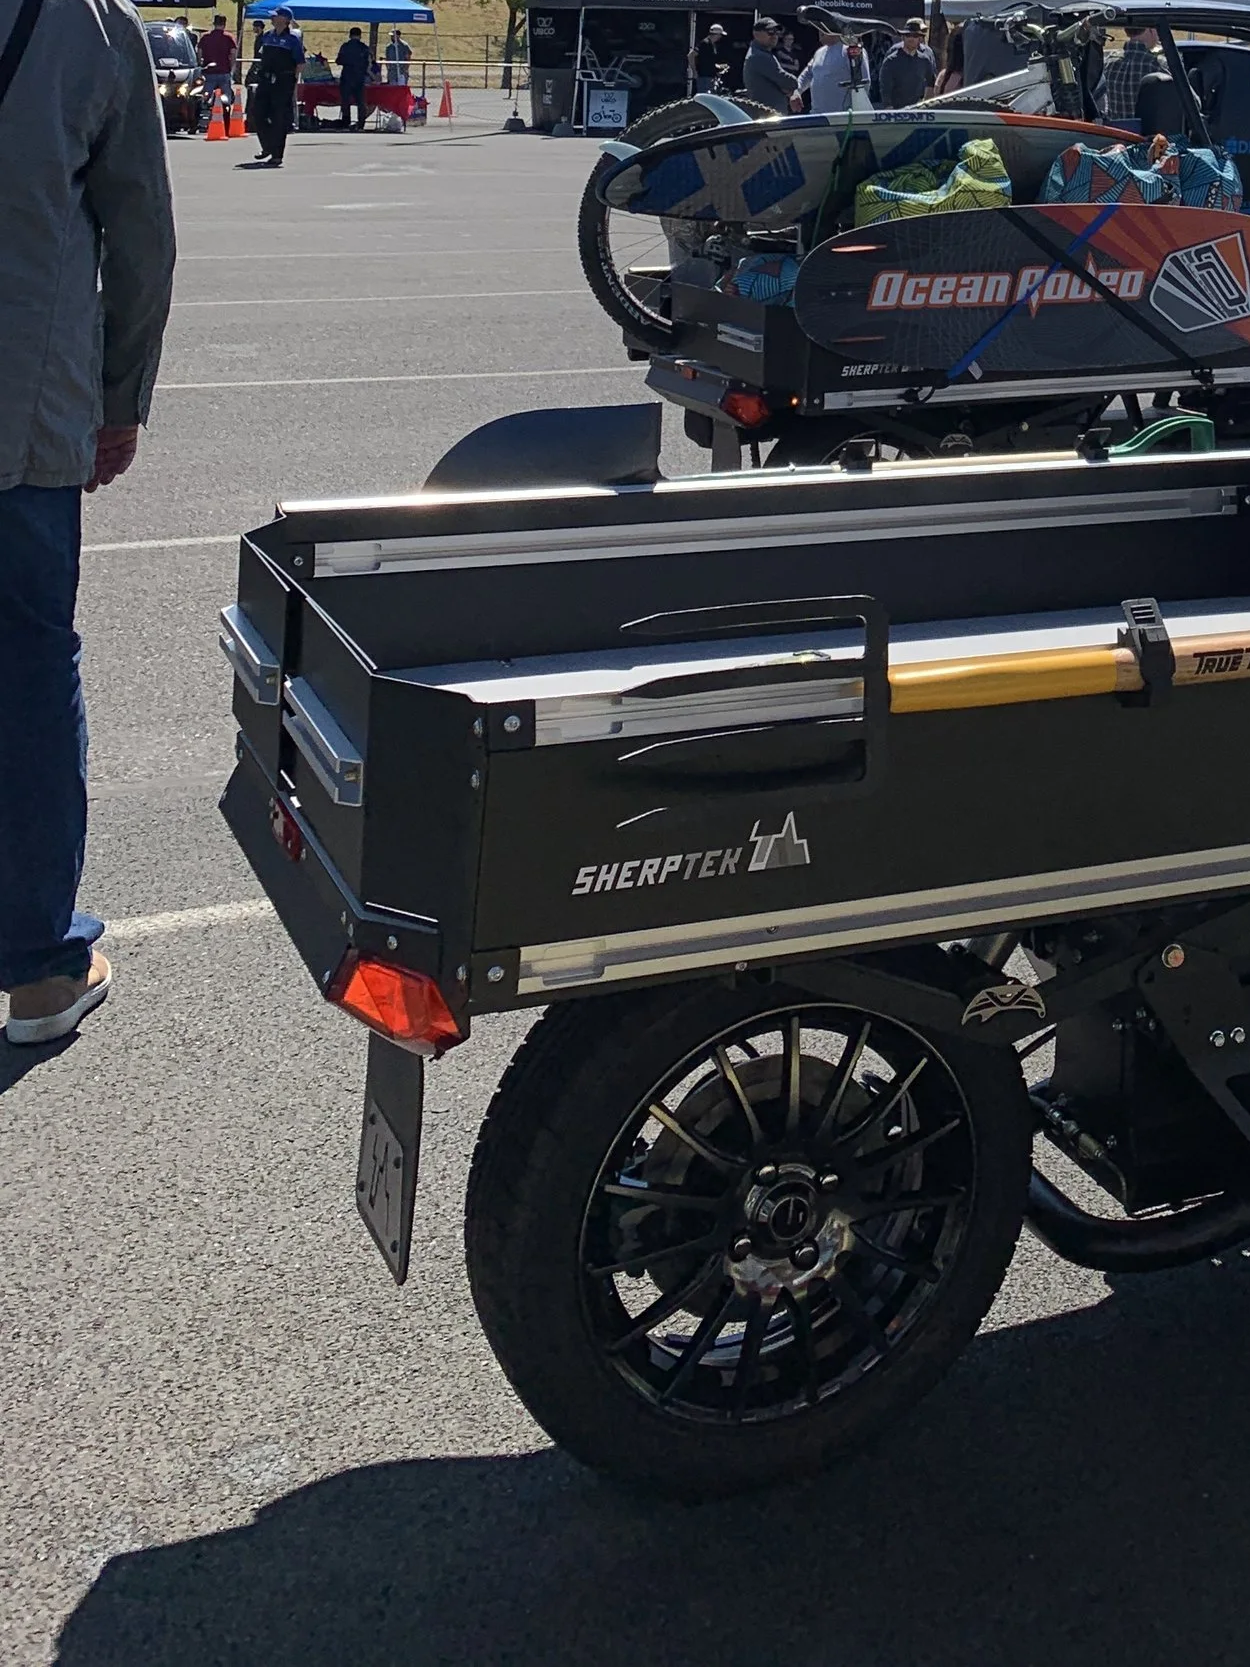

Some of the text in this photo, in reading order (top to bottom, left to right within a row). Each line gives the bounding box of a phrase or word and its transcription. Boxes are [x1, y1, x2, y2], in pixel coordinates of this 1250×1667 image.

[814, 0, 873, 9] ubcobikes.com
[872, 112, 935, 123] SLINGSHOT
[867, 270, 1012, 310] Ocean
[1193, 648, 1244, 675] TRUE
[571, 847, 743, 896] SHERPTEK
